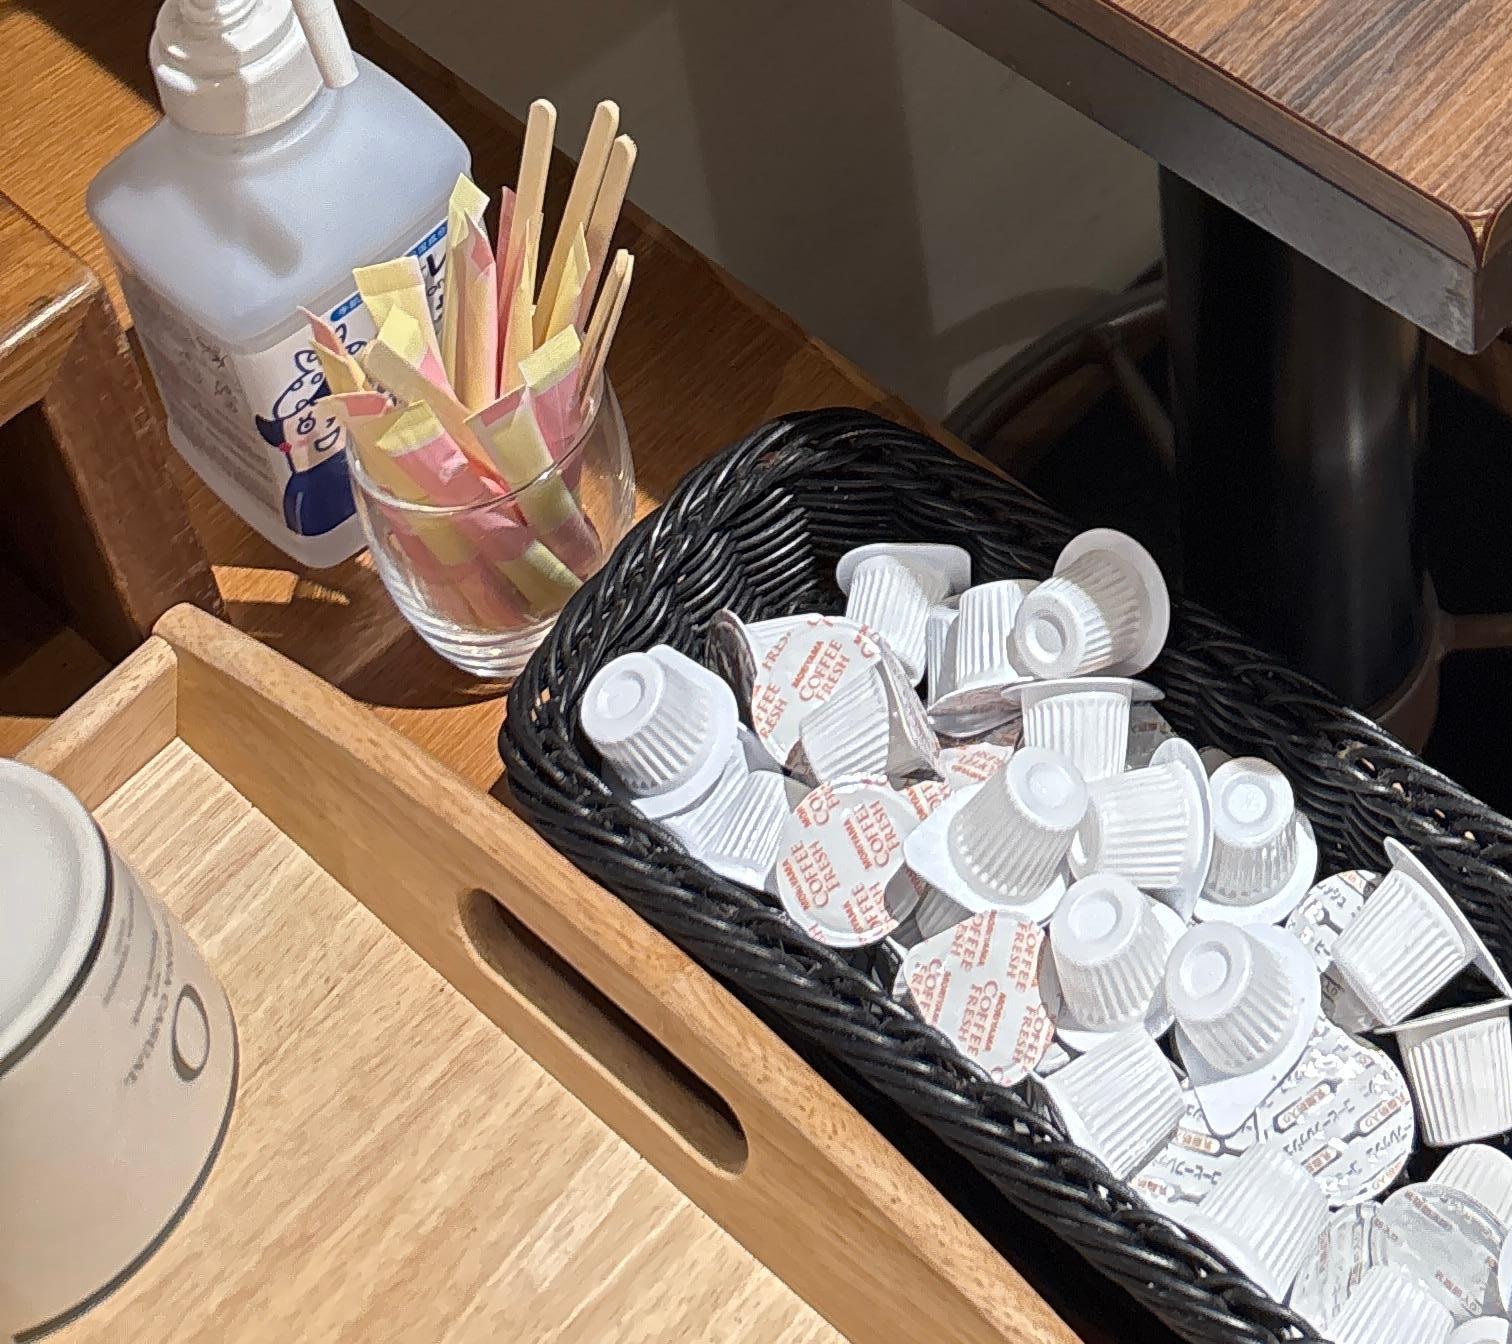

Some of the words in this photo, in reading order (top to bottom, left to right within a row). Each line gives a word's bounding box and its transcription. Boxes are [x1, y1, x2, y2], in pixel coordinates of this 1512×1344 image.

[792, 640, 824, 688] MORIYAMA
[799, 639, 843, 702] COFFEE
[814, 654, 850, 702] FRESH
[843, 818, 873, 871] MORIYAMA
[854, 803, 890, 869] COFFEE
[869, 799, 901, 852] FRESH
[782, 859, 811, 912] MORIYAMA
[790, 840, 829, 908] COFFEE
[807, 839, 841, 892] FRESH
[1006, 921, 1028, 980] FRESH
[920, 958, 943, 1014] COFF
[957, 983, 983, 1042] FRESH
[966, 980, 999, 1057] COFFEE
[984, 992, 1007, 1052] MORIYAMA
